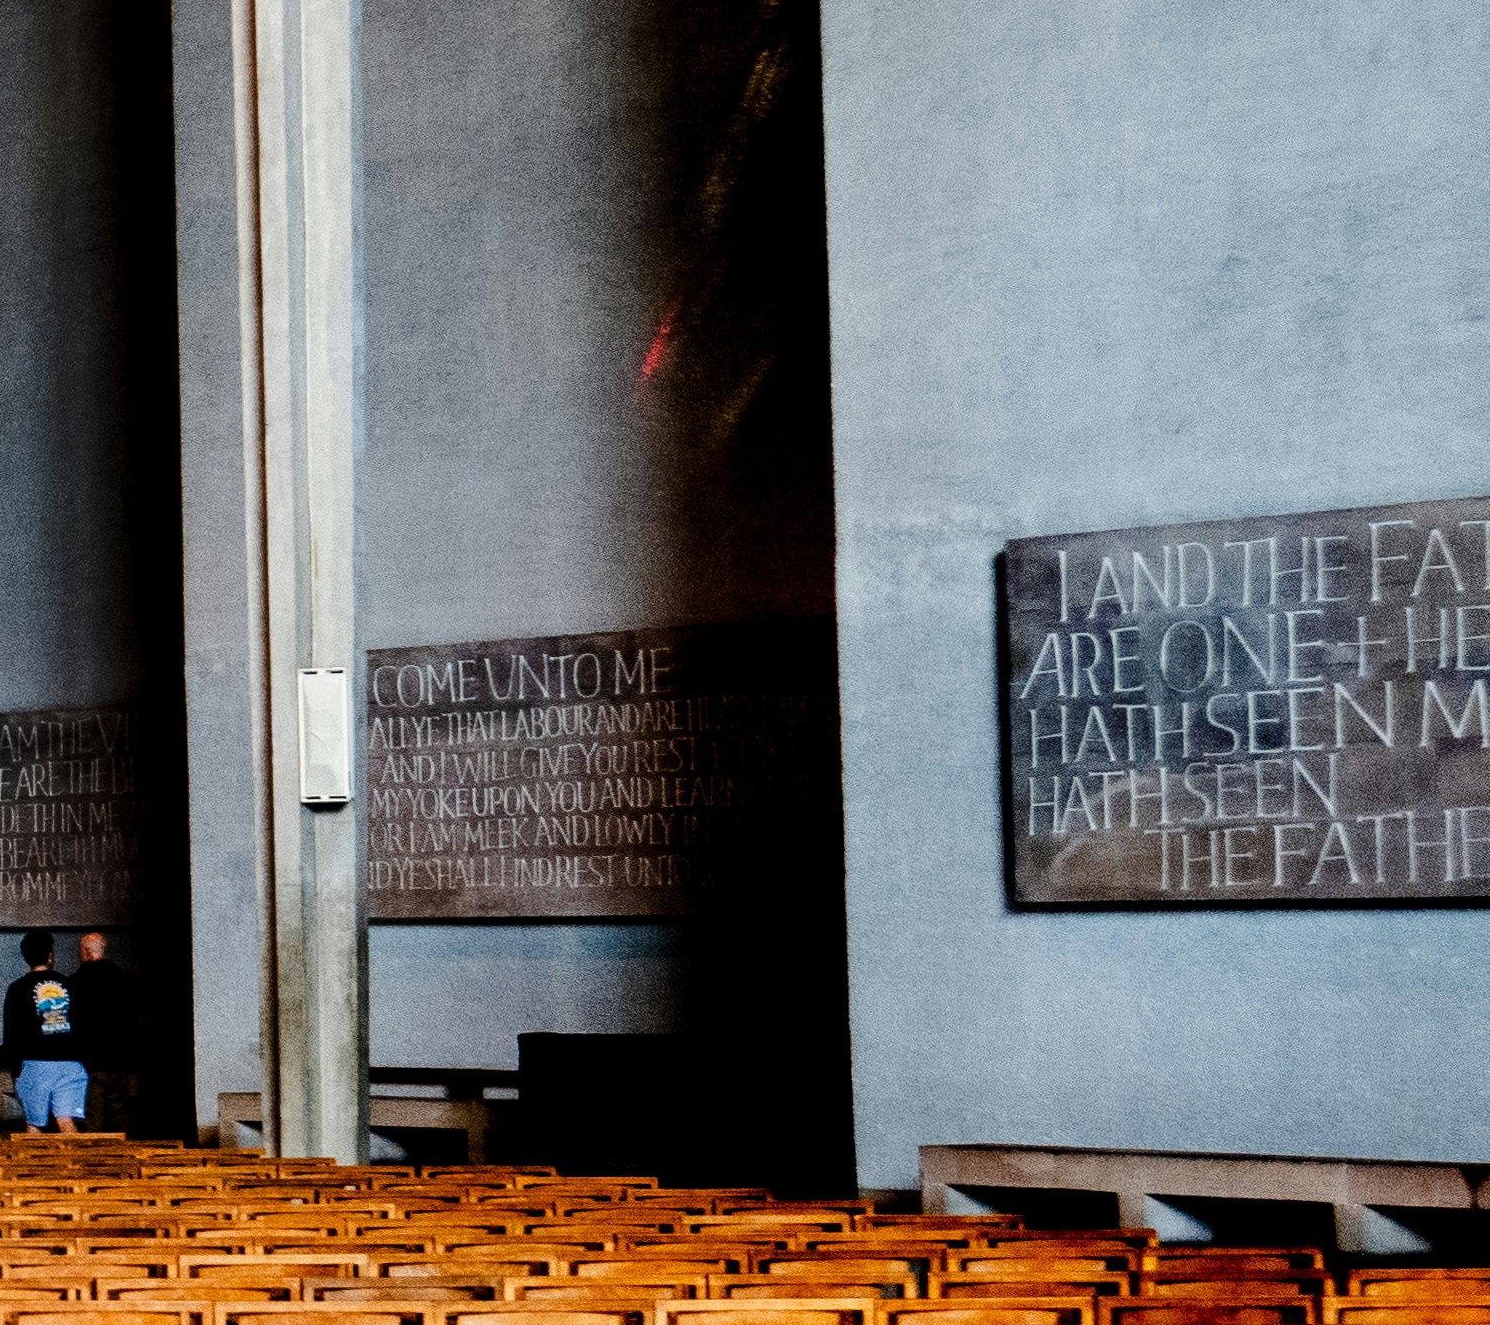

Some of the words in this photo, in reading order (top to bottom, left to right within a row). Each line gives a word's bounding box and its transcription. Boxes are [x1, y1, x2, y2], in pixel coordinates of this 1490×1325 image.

[1058, 549, 1069, 623] I
[1087, 540, 1216, 620] AND
[1223, 536, 1350, 608] THE
[1019, 626, 1145, 701] ARE
[1159, 608, 1325, 694] ONE
[1404, 604, 1490, 675] HE
[372, 659, 478, 709] COME
[483, 653, 602, 701] UNTO
[614, 646, 672, 696] ME
[40, 717, 94, 759] THE
[368, 716, 412, 750] ALL
[411, 716, 442, 748] YE
[441, 710, 499, 746] THAT
[500, 700, 598, 742] LABOUR
[596, 702, 641, 736] AND
[641, 697, 685, 733] ARE
[1029, 701, 1192, 769] HATH
[1203, 680, 1396, 759] SEEN
[14, 762, 65, 802] ARE
[64, 757, 108, 796] THE
[379, 754, 436, 784] AND
[452, 749, 518, 785] WILL
[519, 742, 580, 780] GIVE
[579, 741, 629, 776] YOU
[632, 736, 702, 775] REST
[60, 801, 84, 834] IN
[88, 800, 124, 833] ME
[371, 787, 405, 819] MY
[404, 786, 471, 820] YOKE
[471, 784, 541, 818] UPON
[544, 780, 597, 814] YOU
[598, 776, 654, 813] AND
[1026, 767, 1171, 837] HATH
[1181, 753, 1340, 824] SEEN
[0, 835, 96, 871] BEARETH
[420, 821, 458, 853] AM
[463, 816, 530, 852] MEEK
[533, 814, 591, 848] AND
[593, 812, 677, 849] LOWLY
[393, 857, 424, 891] YE
[423, 855, 498, 890] SHALL
[553, 854, 619, 889] REST
[623, 853, 694, 888] UNTO
[1143, 824, 1261, 892] THE
